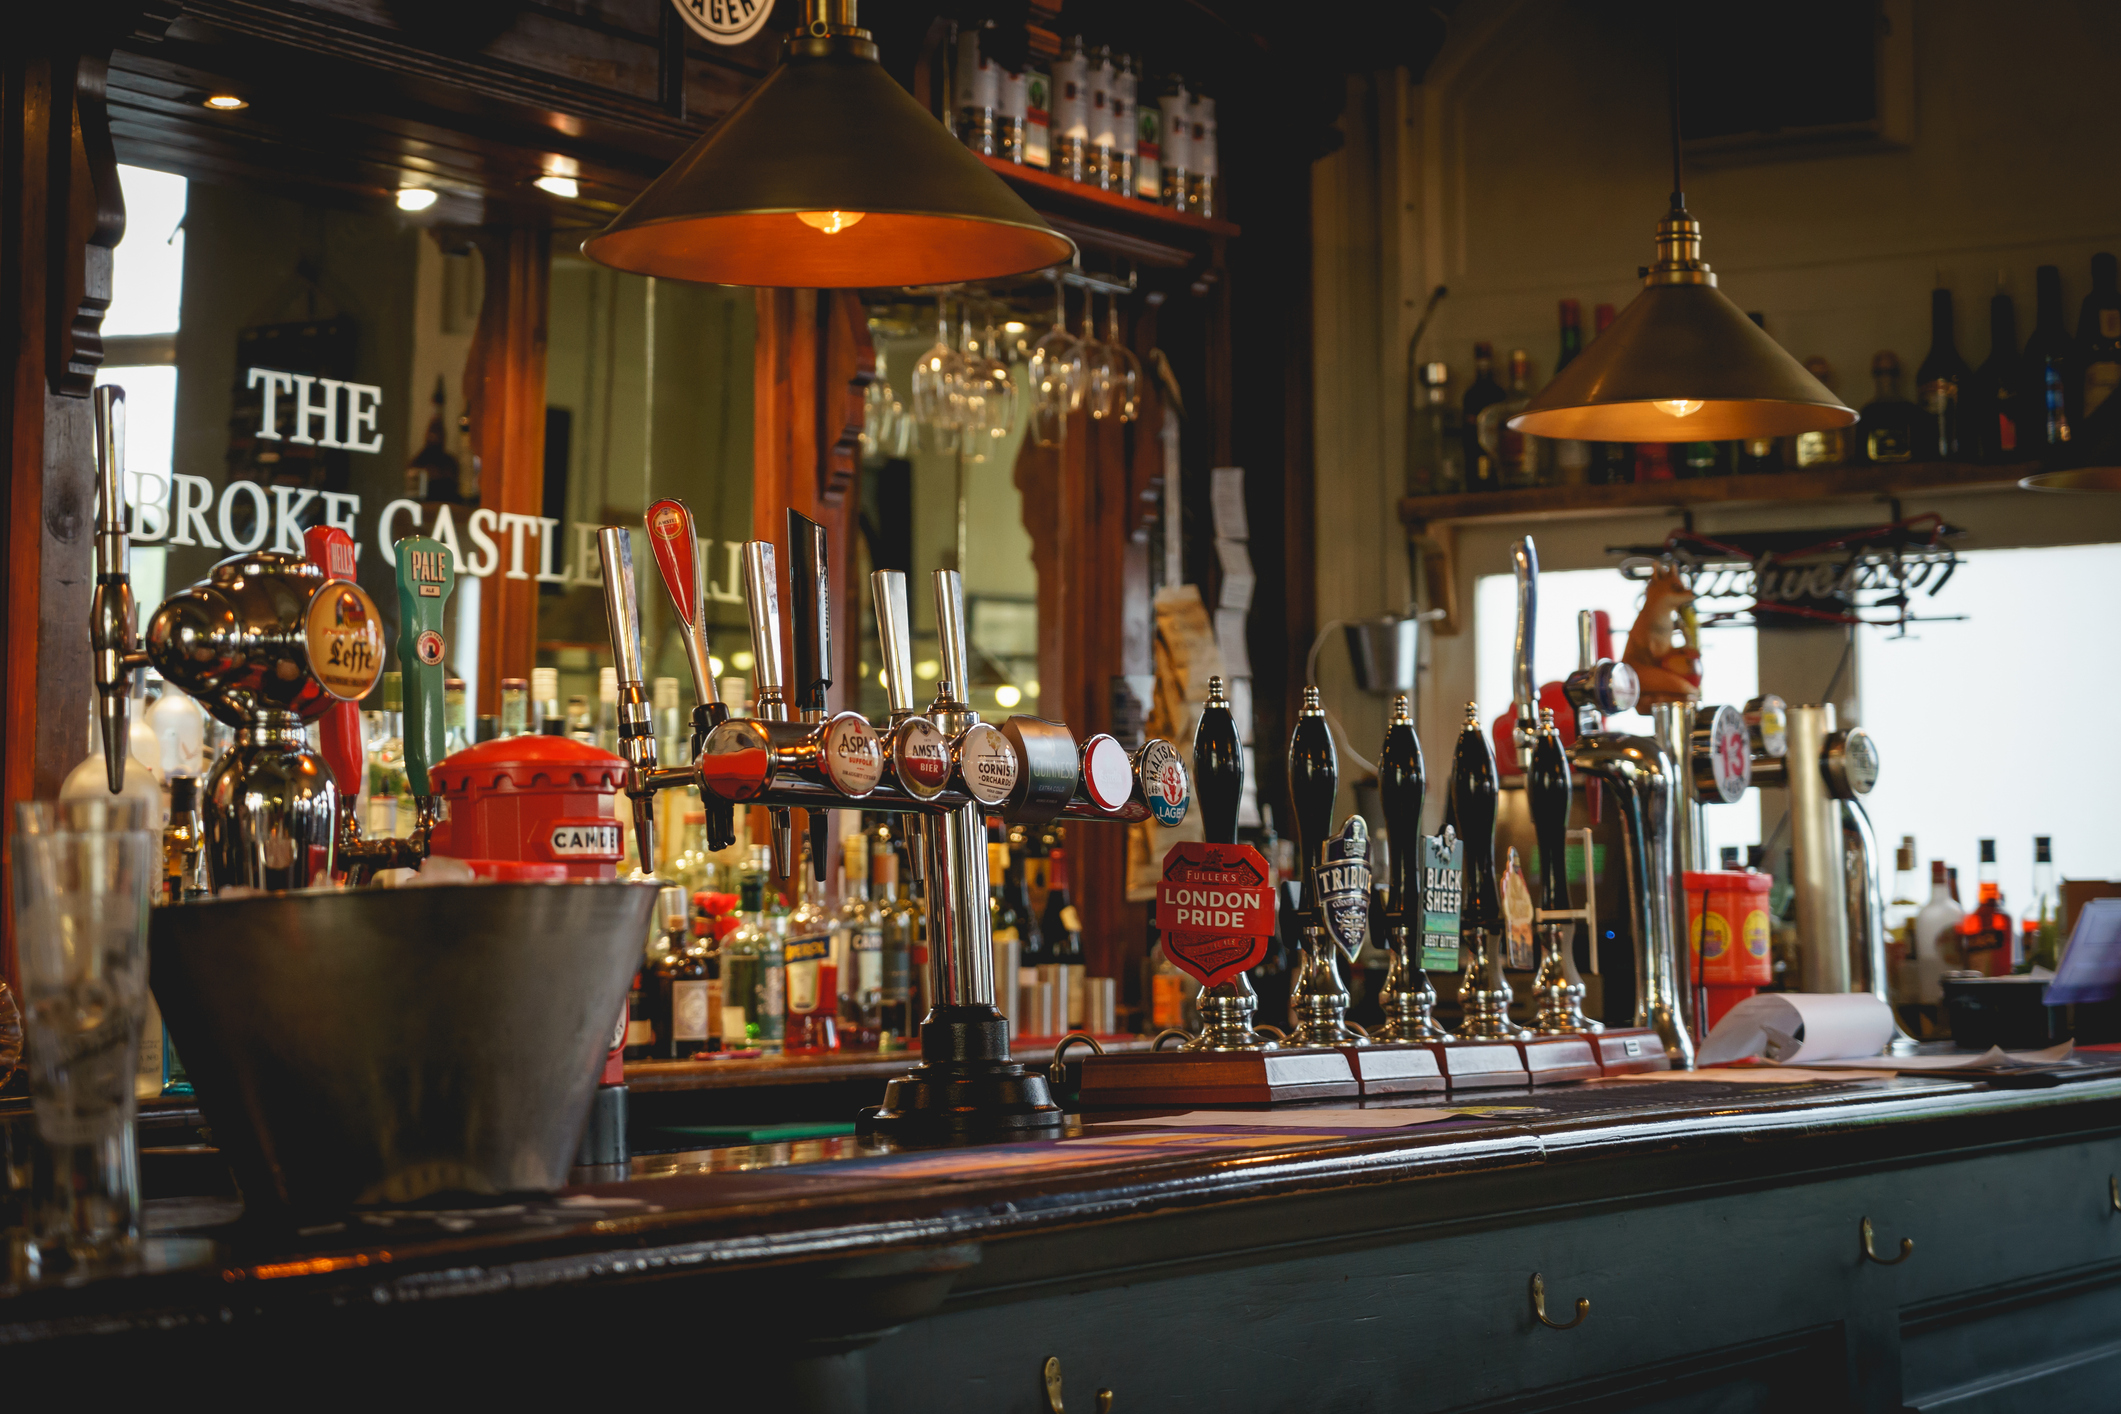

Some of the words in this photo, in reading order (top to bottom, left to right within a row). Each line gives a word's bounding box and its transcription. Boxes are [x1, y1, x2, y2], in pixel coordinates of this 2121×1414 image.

[247, 366, 384, 454] THE
[331, 543, 354, 576] HELLS
[411, 550, 447, 583] PALE
[328, 637, 375, 673] Leffe
[849, 756, 873, 767] SUFFOLK
[1719, 733, 1744, 776] 13
[920, 763, 939, 774] BIER
[978, 763, 1016, 777] CORNISH
[1033, 757, 1075, 779] GUINNESS
[981, 776, 1011, 787] ORCHARDS
[1038, 784, 1052, 792] EXTRA
[1159, 806, 1186, 819] LAGER
[1427, 868, 1462, 892] BLACK
[1165, 888, 1260, 910] LONDON
[1426, 891, 1461, 913] SHEEP
[1177, 908, 1245, 928] PRIDE
[1425, 934, 1439, 947] BEST
